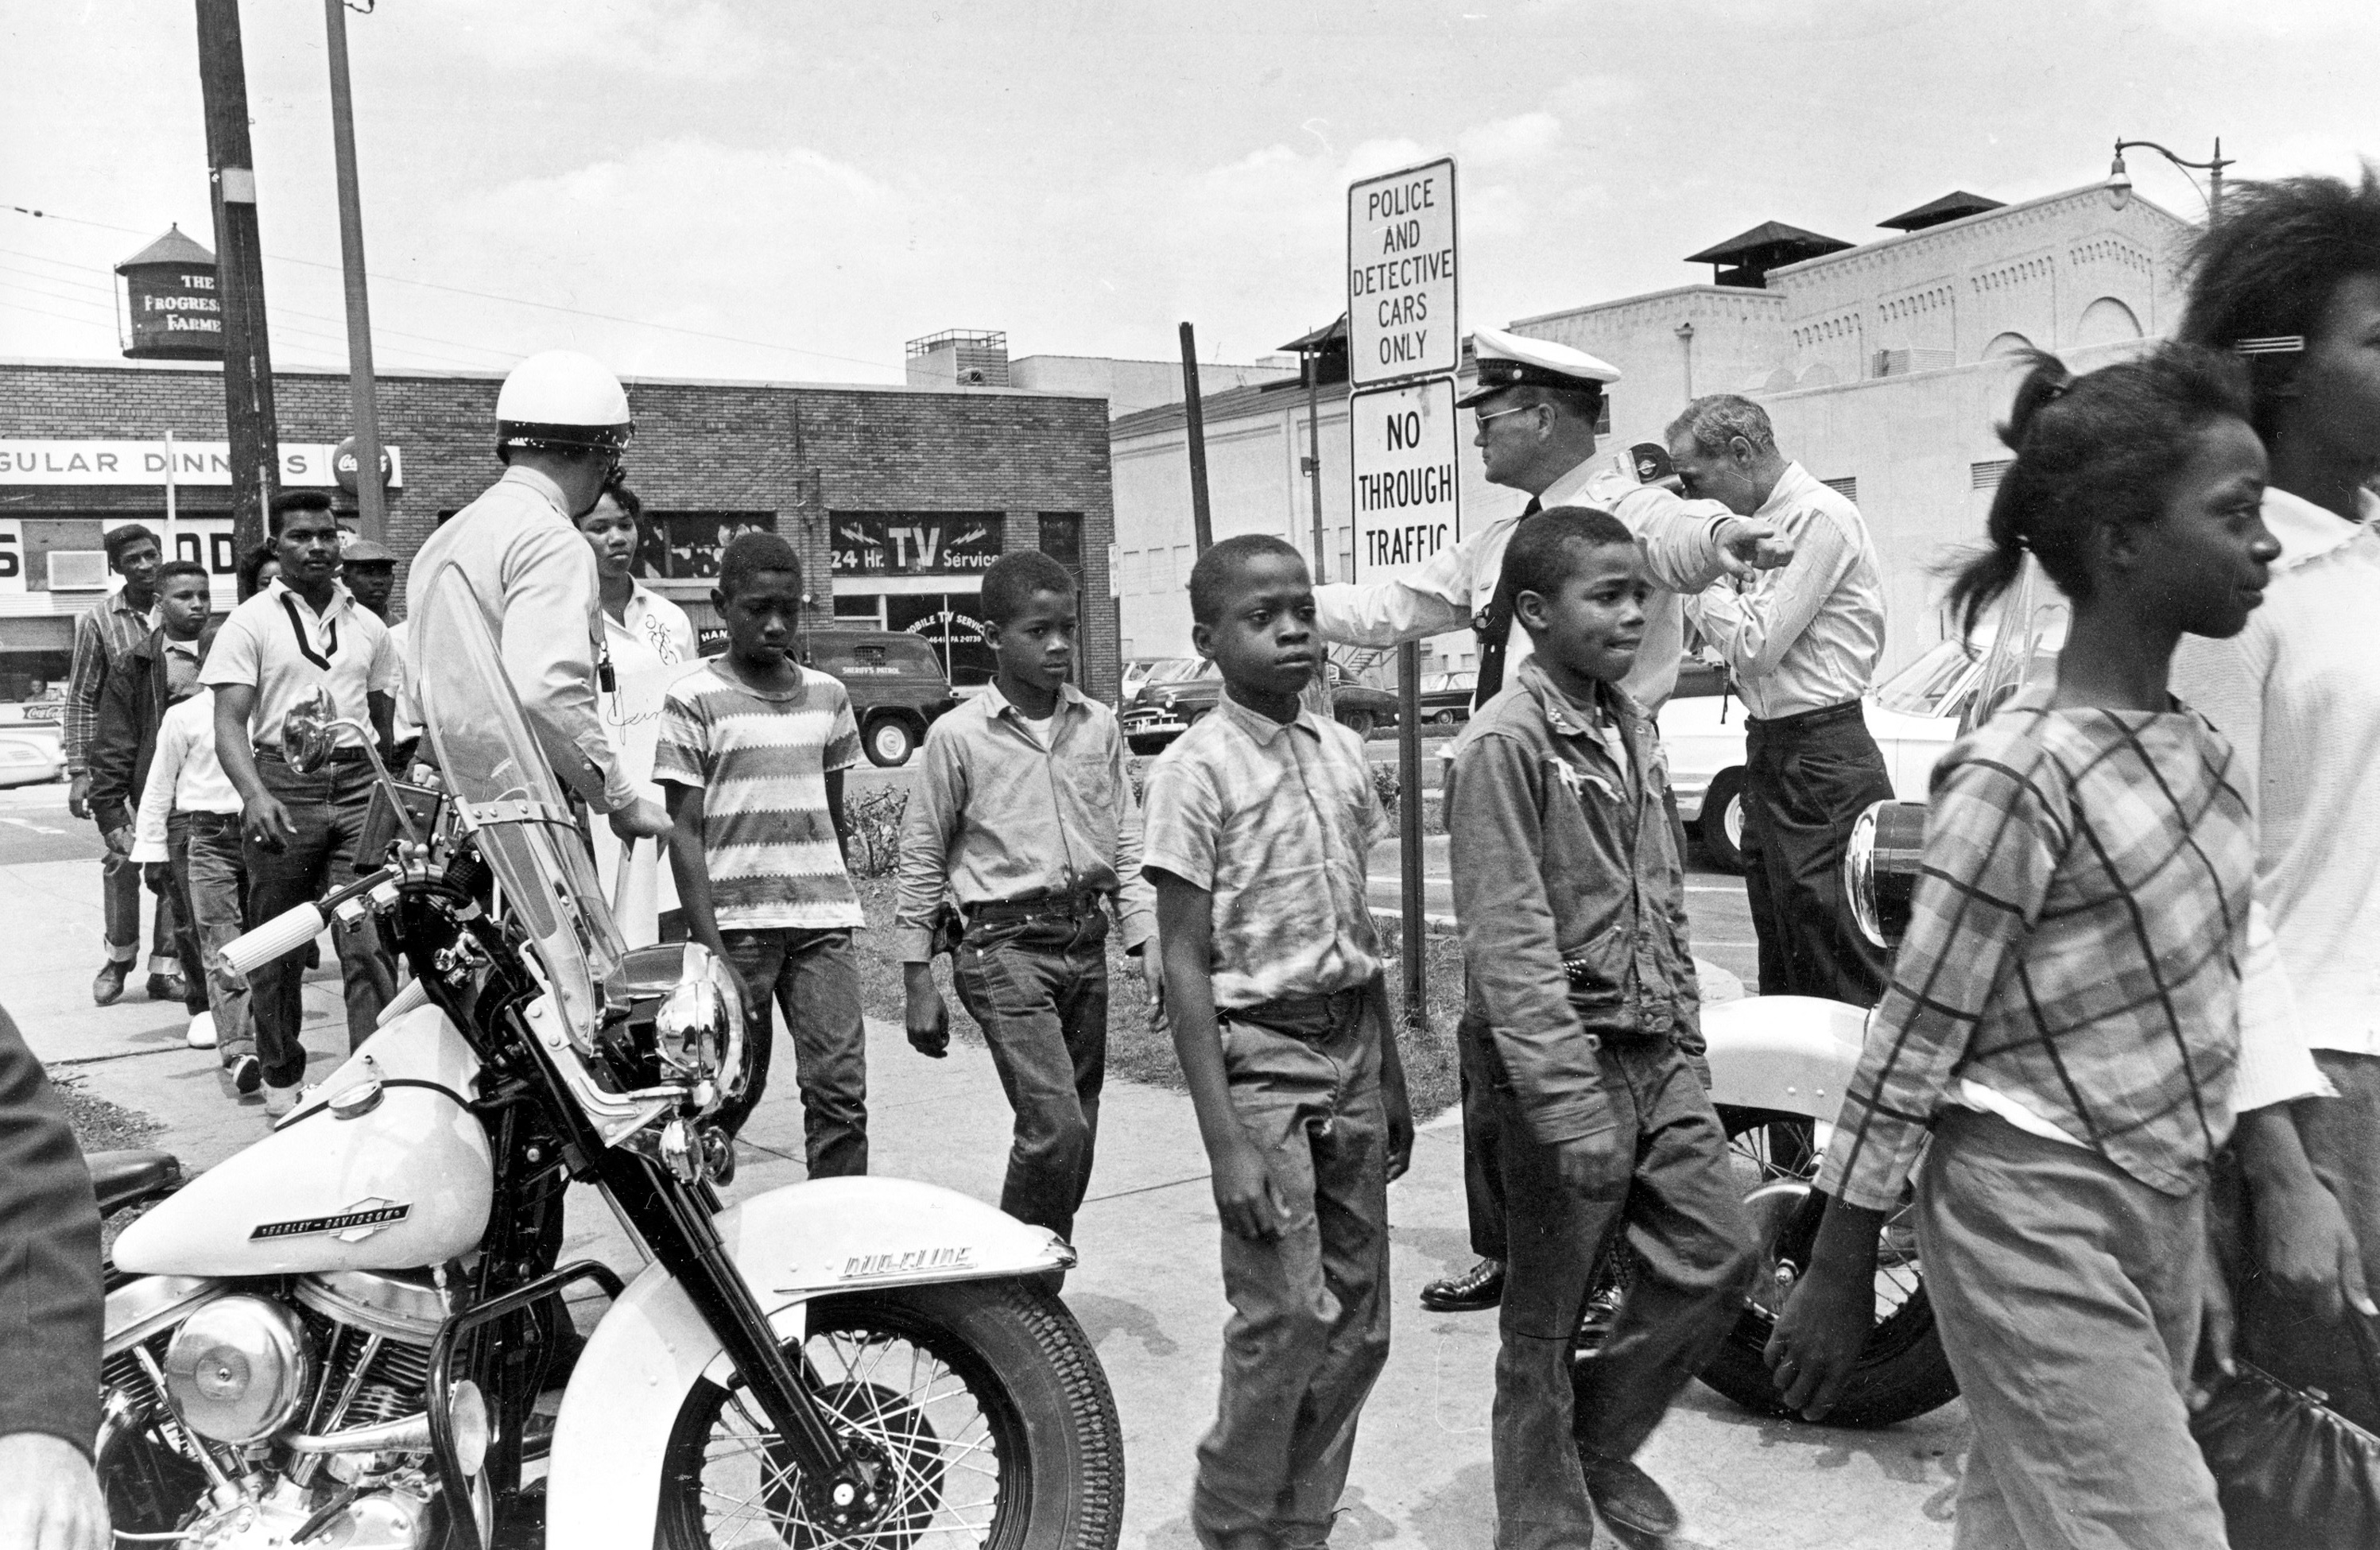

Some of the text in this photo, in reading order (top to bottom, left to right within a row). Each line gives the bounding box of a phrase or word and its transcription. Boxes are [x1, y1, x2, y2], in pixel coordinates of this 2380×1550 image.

[1369, 178, 1435, 222] POLICE
[1383, 219, 1421, 255] AND
[180, 274, 215, 290] THE
[1353, 248, 1453, 297] DETECTIVE
[144, 294, 221, 312] PROGRES
[1378, 292, 1428, 328] CARS
[165, 313, 222, 333] FARME
[1380, 329, 1428, 366] ONLY
[1386, 410, 1421, 452] NO
[144, 452, 308, 475] DINNS
[1358, 463, 1452, 511] THROUGH
[831, 527, 1001, 569] 24 Hr. TV Service
[1366, 523, 1448, 567] TRAFFIC
[937, 610, 955, 623] TV
